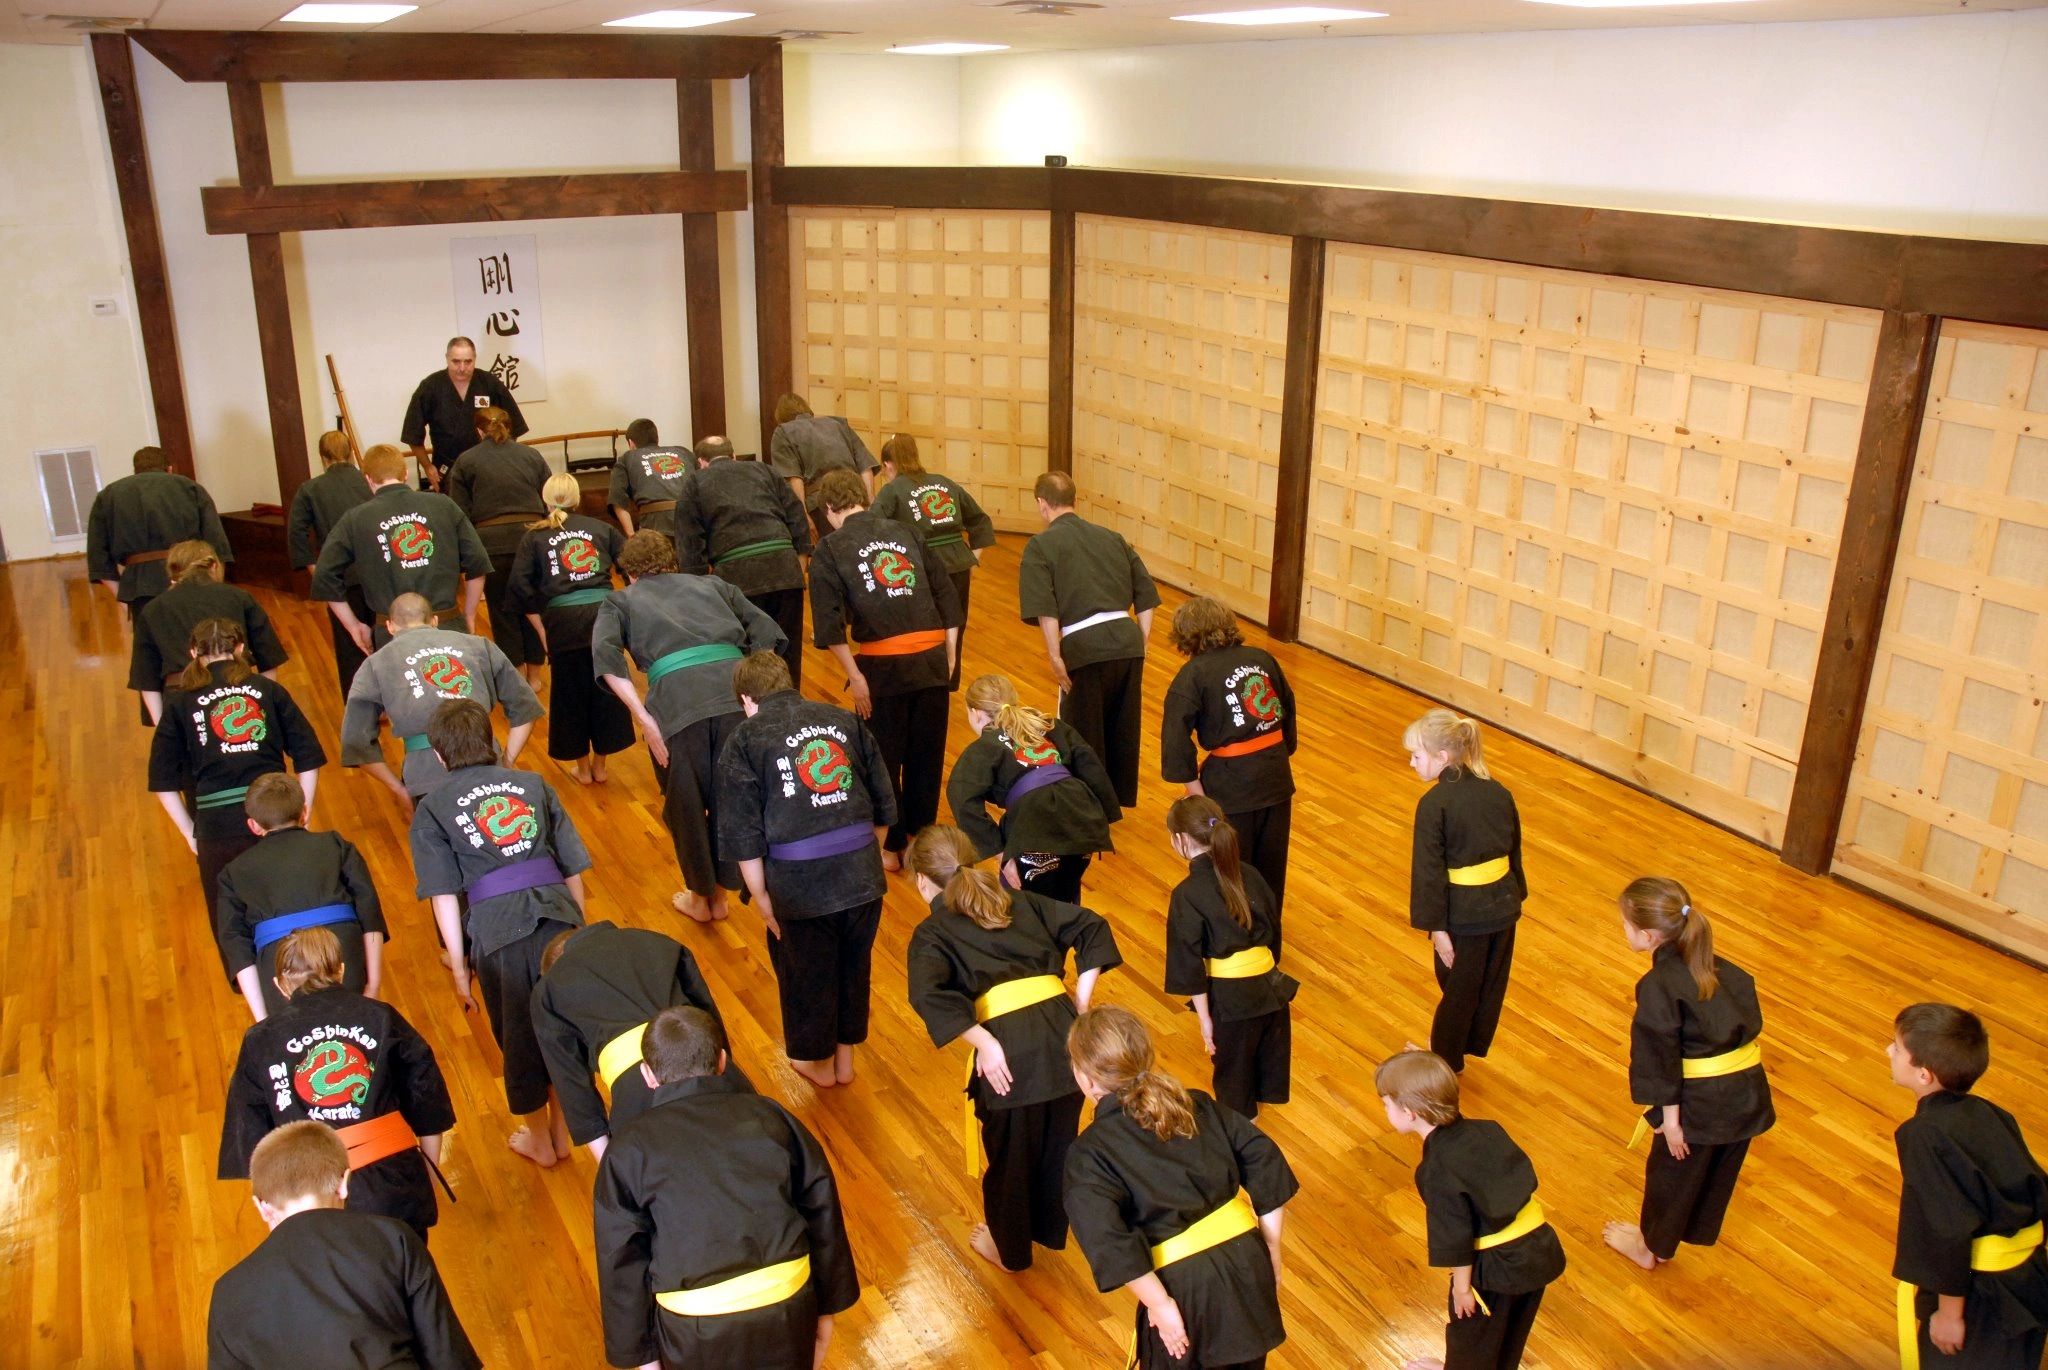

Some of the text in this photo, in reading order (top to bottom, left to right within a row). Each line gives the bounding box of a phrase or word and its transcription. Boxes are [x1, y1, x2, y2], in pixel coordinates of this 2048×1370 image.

[400, 557, 429, 569] Karate
[197, 685, 262, 705] GoShinKan
[786, 726, 847, 747] GoShinKan
[220, 741, 259, 753] Karate
[457, 782, 525, 806] GoShinKan
[810, 790, 848, 807] Karate
[501, 840, 531, 856] arate
[286, 1024, 378, 1053] GoShinKan
[308, 1103, 361, 1121] Karate
